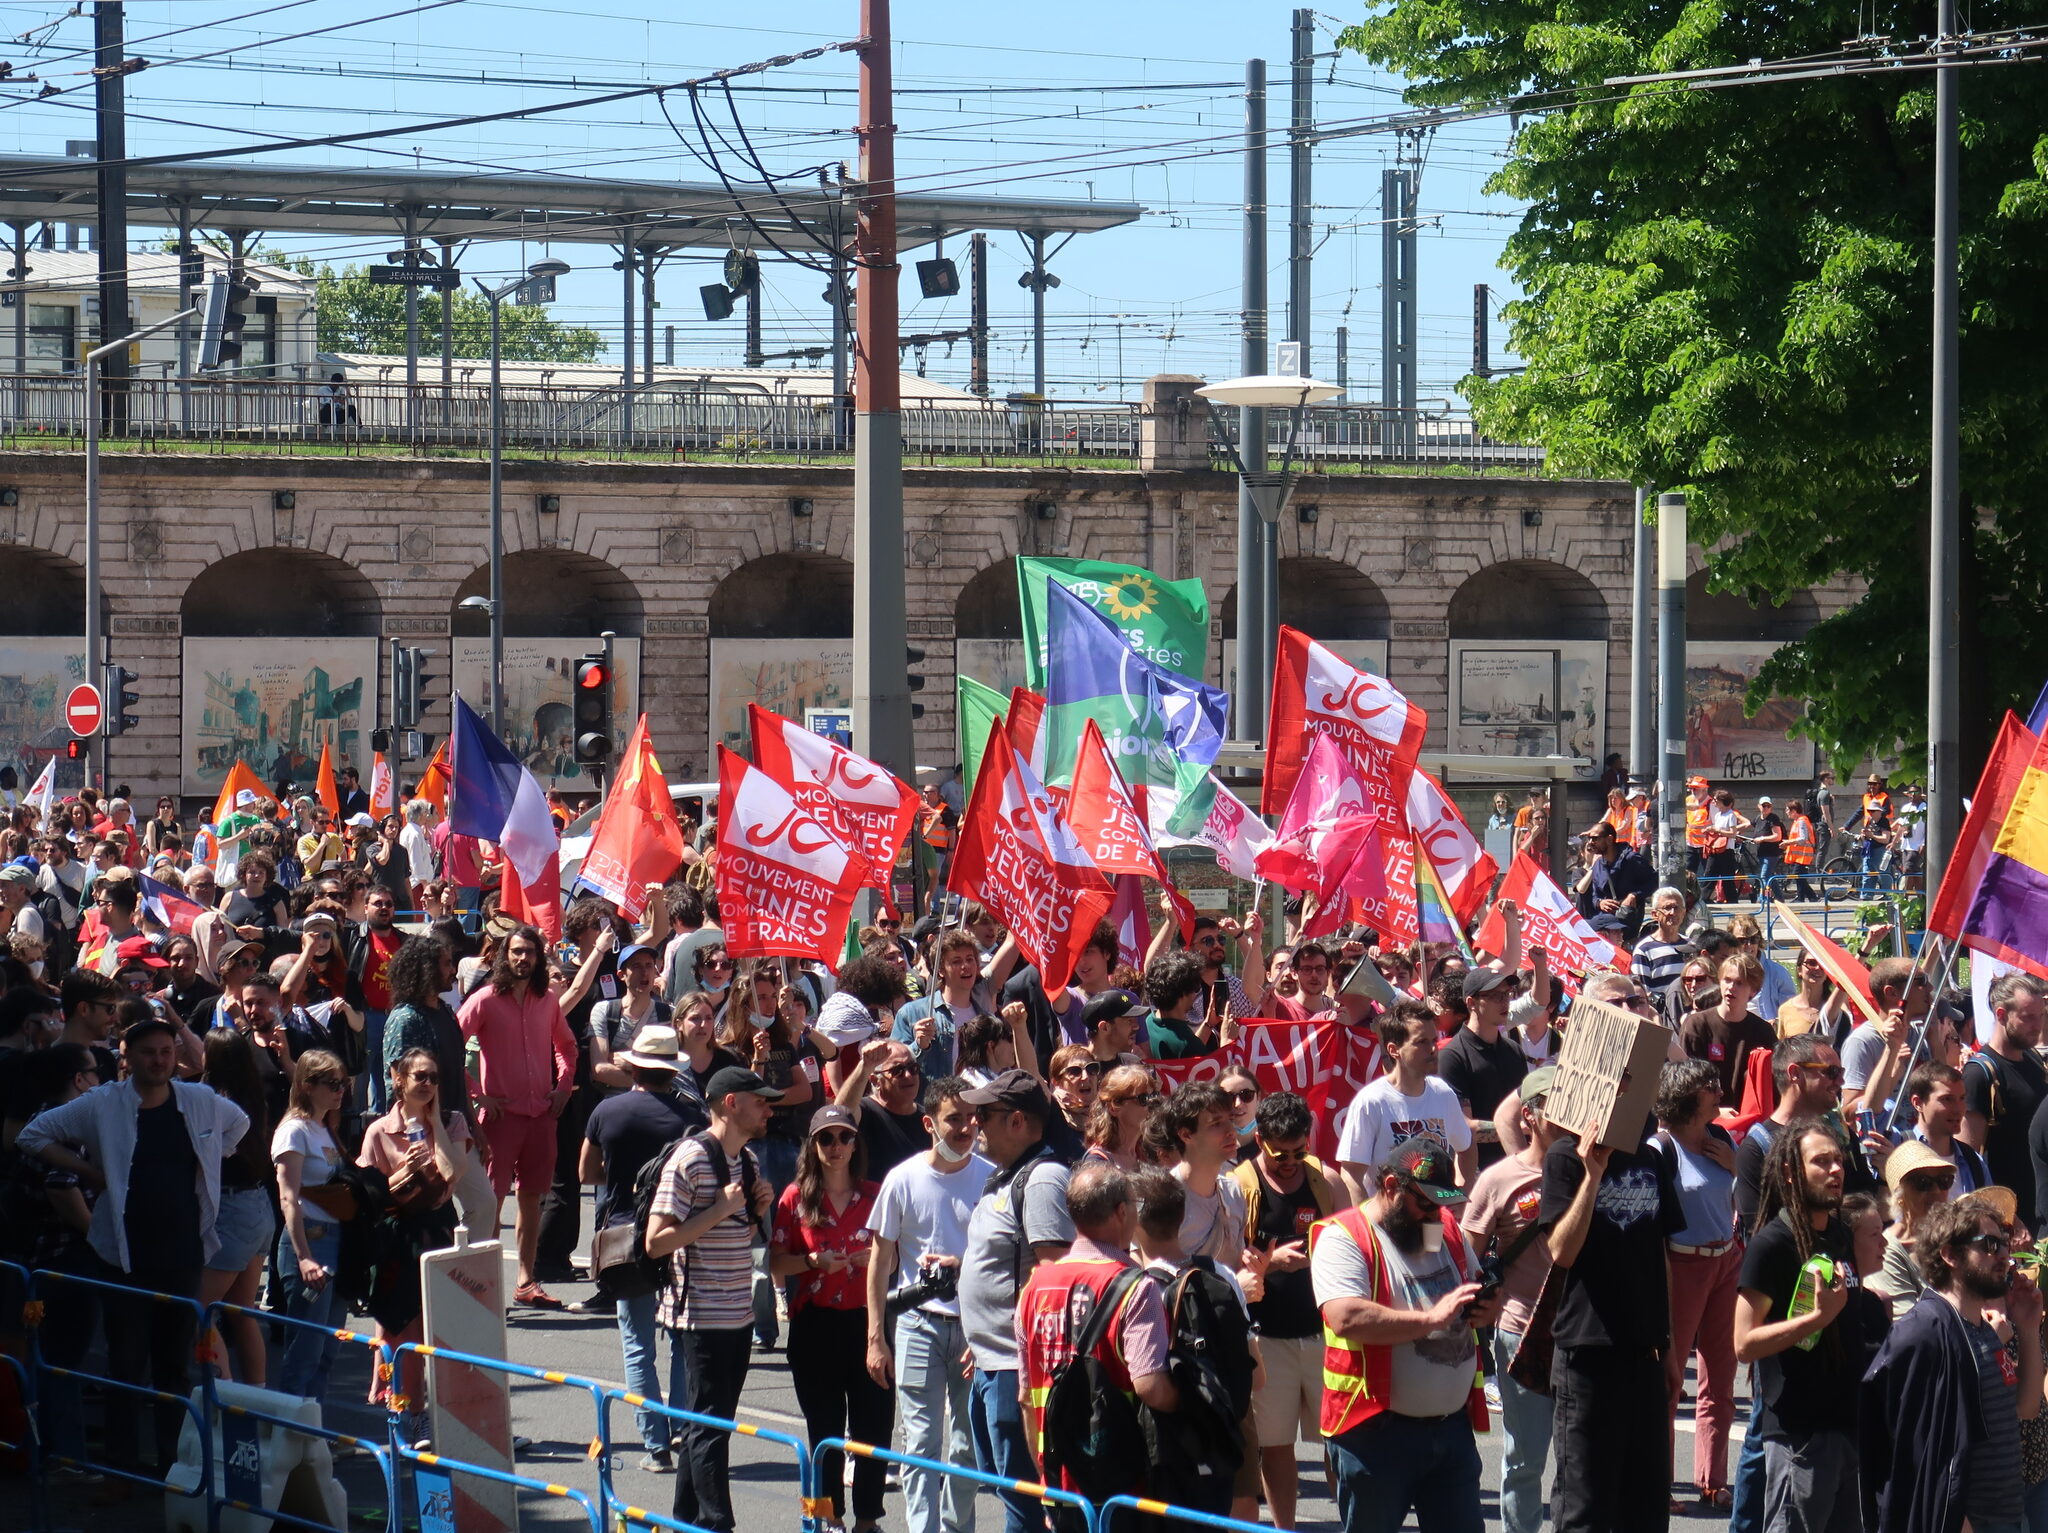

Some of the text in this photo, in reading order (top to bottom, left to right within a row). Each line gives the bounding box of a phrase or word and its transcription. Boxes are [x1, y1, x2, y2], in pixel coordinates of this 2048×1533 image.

[1281, 350, 1294, 371] Z
[1303, 717, 1395, 766] MOUVEMENT
[1723, 752, 1767, 779] ACAB
[1095, 843, 1124, 860] DE
[717, 852, 835, 906] MOUVEMENT
[987, 842, 1073, 933] JEUNES
[715, 873, 828, 936] JEUNES
[979, 881, 999, 909] DE
[1299, 1212, 1315, 1223] cgt
